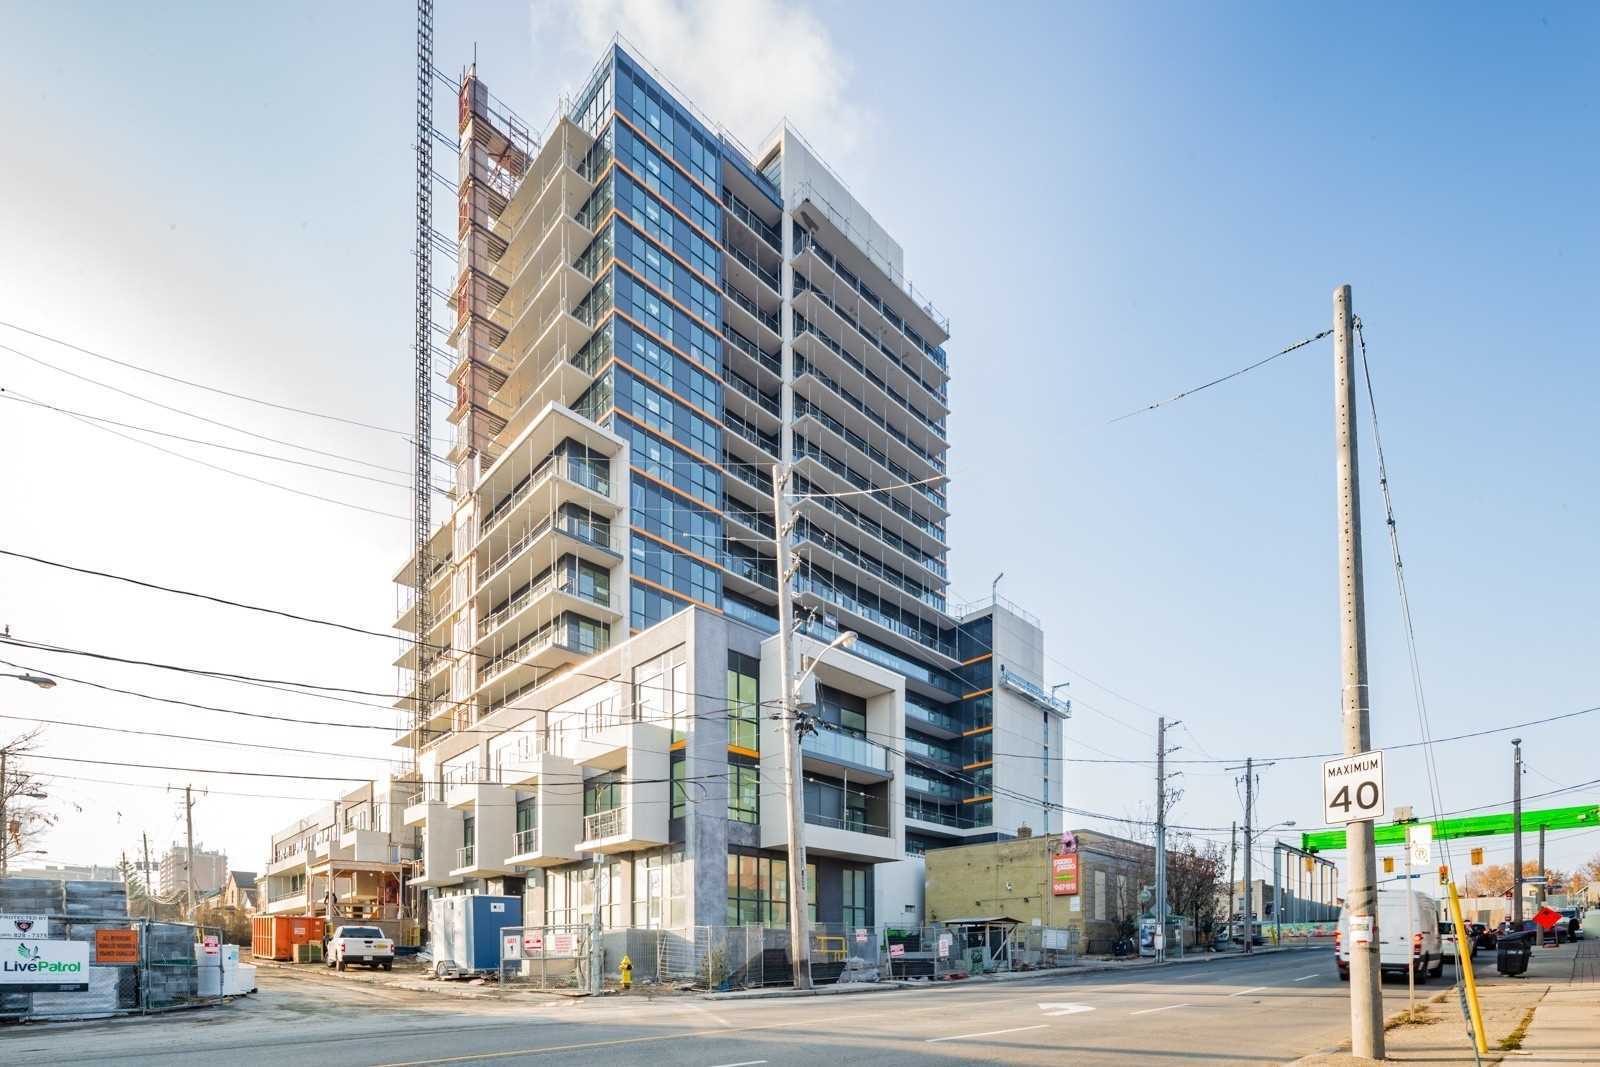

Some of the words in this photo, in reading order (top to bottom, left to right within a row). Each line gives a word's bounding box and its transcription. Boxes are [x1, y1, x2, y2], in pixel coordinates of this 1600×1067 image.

[1328, 759, 1378, 777] MAXIMUM
[1329, 781, 1379, 813] 40
[4, 961, 81, 972] LivePatrol
